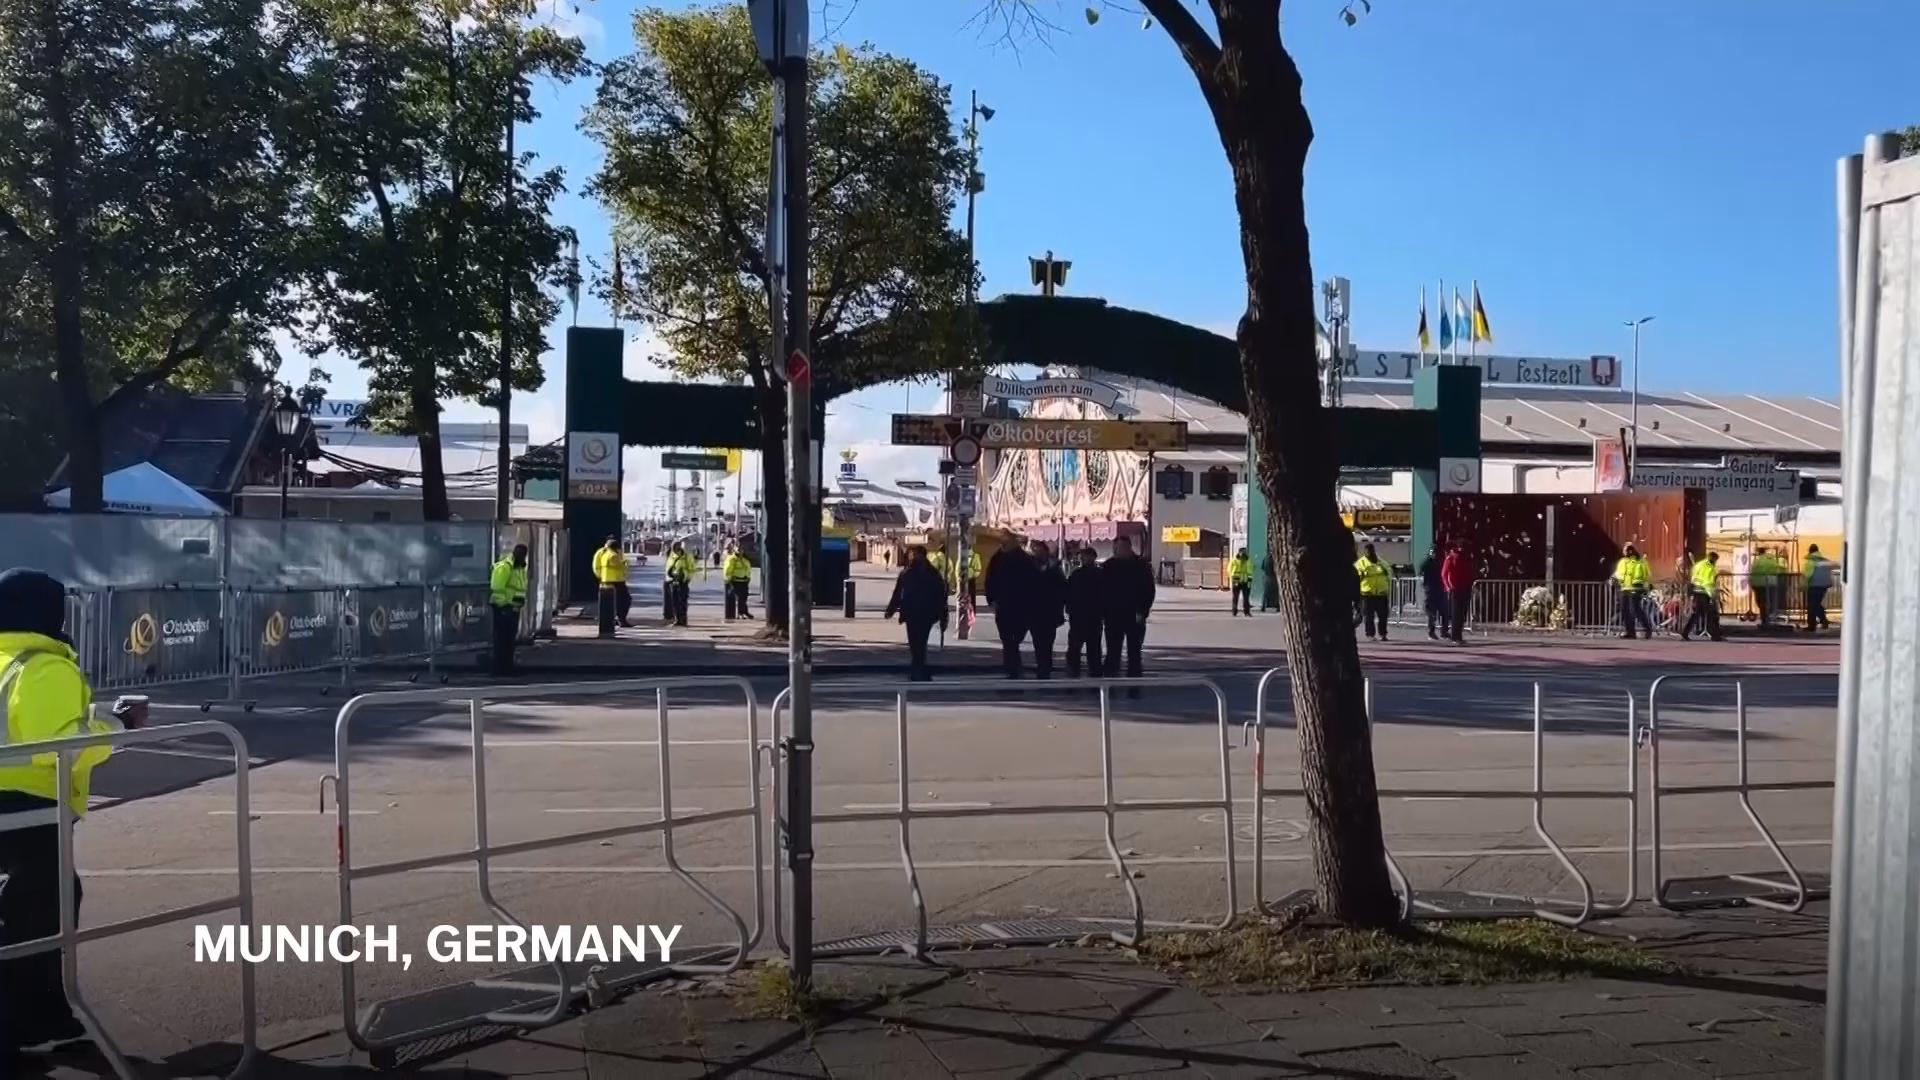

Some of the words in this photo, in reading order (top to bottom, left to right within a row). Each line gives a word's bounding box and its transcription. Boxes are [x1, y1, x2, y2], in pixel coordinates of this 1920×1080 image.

[1517, 359, 1581, 385] Festzelt
[995, 380, 1067, 397] Willkommen
[1070, 383, 1093, 397] zum
[986, 420, 1093, 445] Oktoberfest
[1729, 457, 1775, 474] Galerie
[1634, 471, 1775, 492] eservierungseingang
